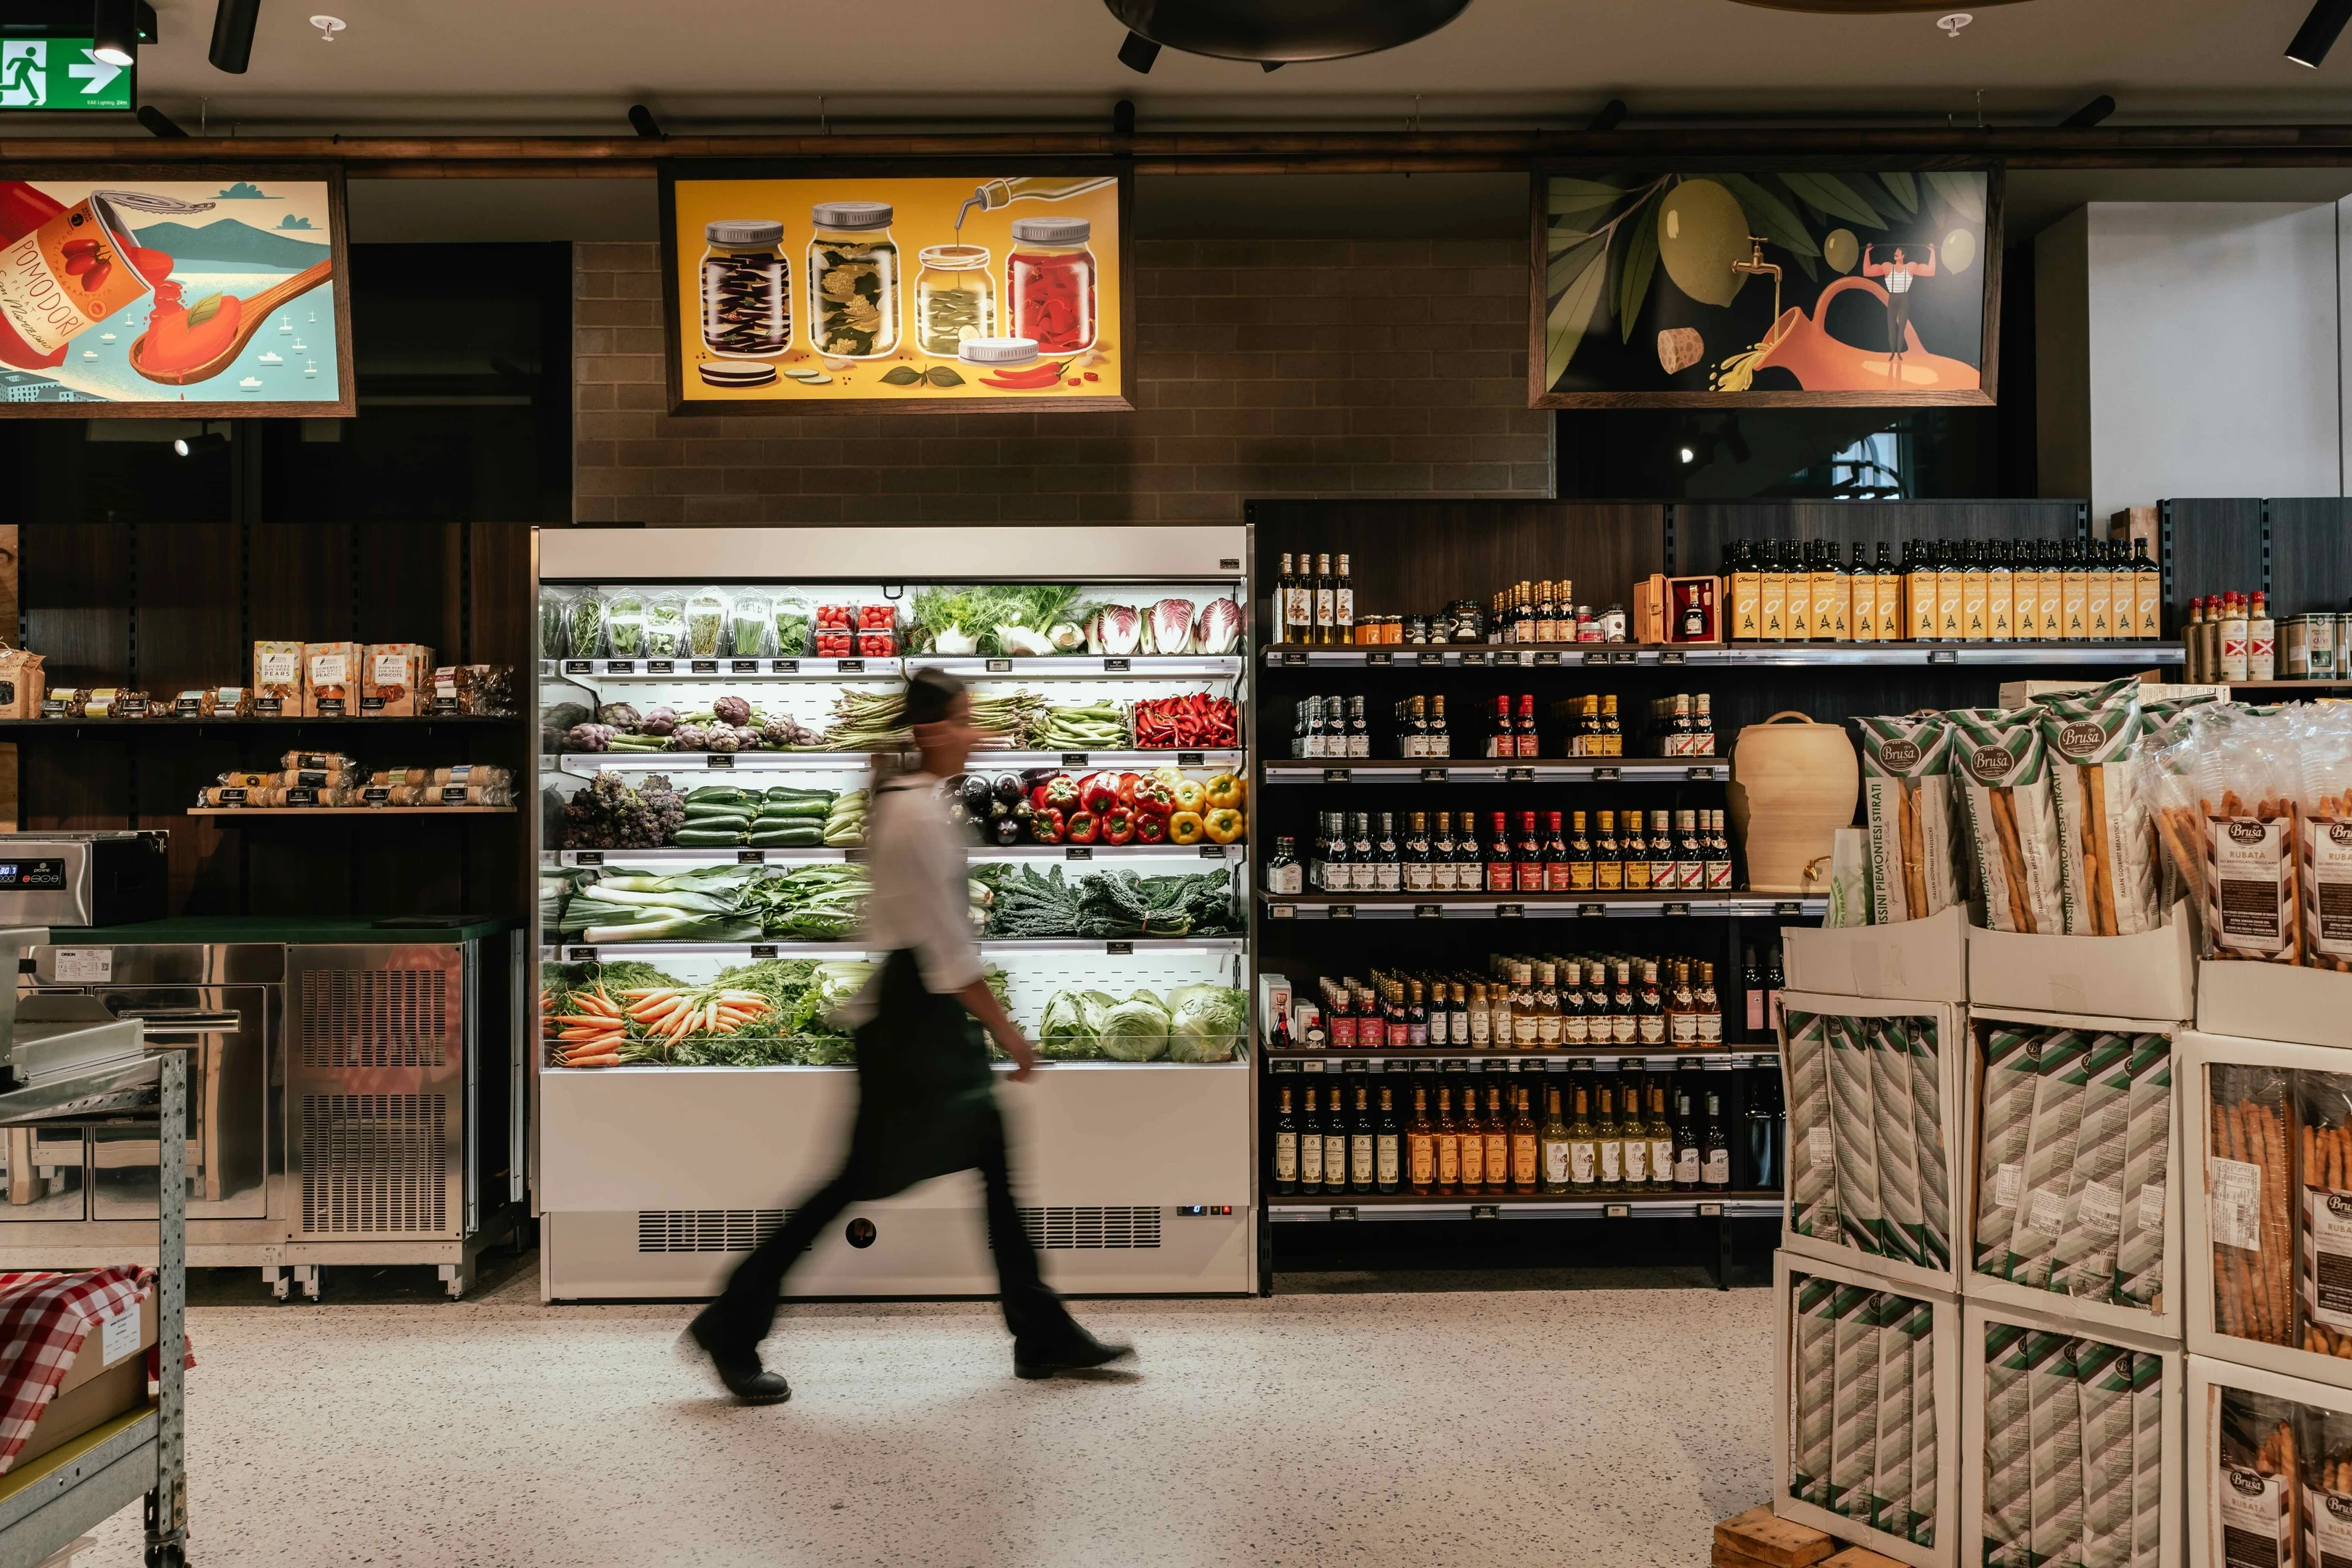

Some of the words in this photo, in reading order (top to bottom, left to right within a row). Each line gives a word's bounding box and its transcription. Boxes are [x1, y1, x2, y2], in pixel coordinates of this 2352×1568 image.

[12, 240, 84, 337] POMODORI
[12, 279, 41, 321] PELATI
[2062, 729, 2099, 745] Brusa
[1882, 746, 1916, 760] Brusa
[1974, 752, 2008, 768] Brusa
[1871, 784, 1882, 822] STIRATI
[2053, 772, 2064, 815] STIRATI
[2231, 824, 2263, 837] Brusa
[1873, 825, 1885, 891] PIEMONTESI
[2028, 838, 2038, 870] BREADSTICKS
[2059, 819, 2070, 887] PIEMONTESI
[2230, 850, 2266, 859] RUBATÀ
[2088, 1246, 2101, 1256] 200g
[2231, 1471, 2262, 1491] Brusa
[2231, 1498, 2266, 1514] RUBATÀ
